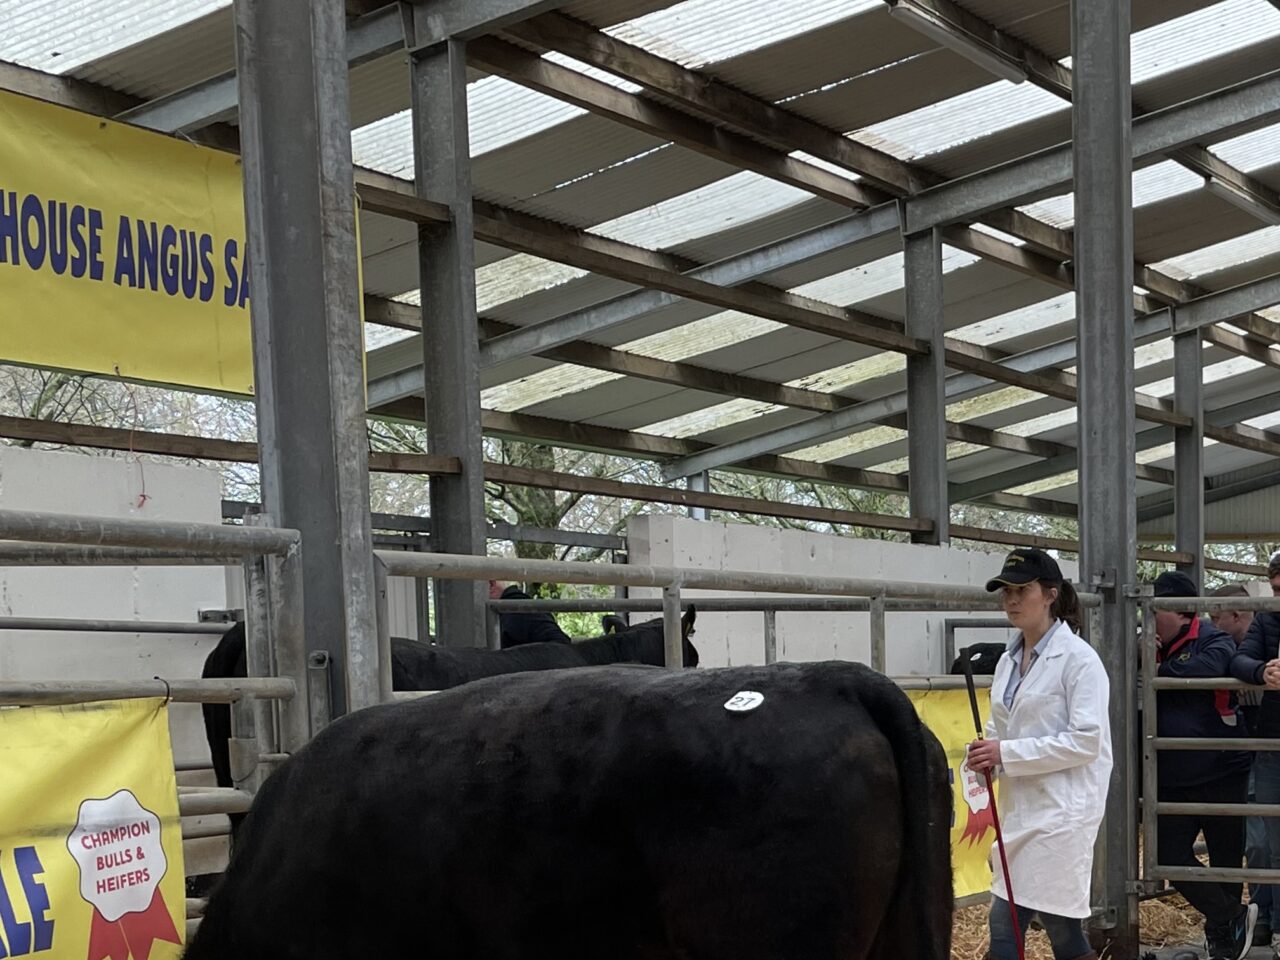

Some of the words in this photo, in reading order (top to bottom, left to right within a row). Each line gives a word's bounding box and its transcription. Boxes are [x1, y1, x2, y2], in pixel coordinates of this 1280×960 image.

[0, 188, 104, 281] HOUSE
[113, 214, 215, 302] ANGUS
[729, 696, 756, 707] 27
[81, 820, 151, 850] CHAMPION
[96, 850, 133, 871] BULLS
[135, 845, 146, 861] &
[96, 867, 151, 895] HEIFERS
